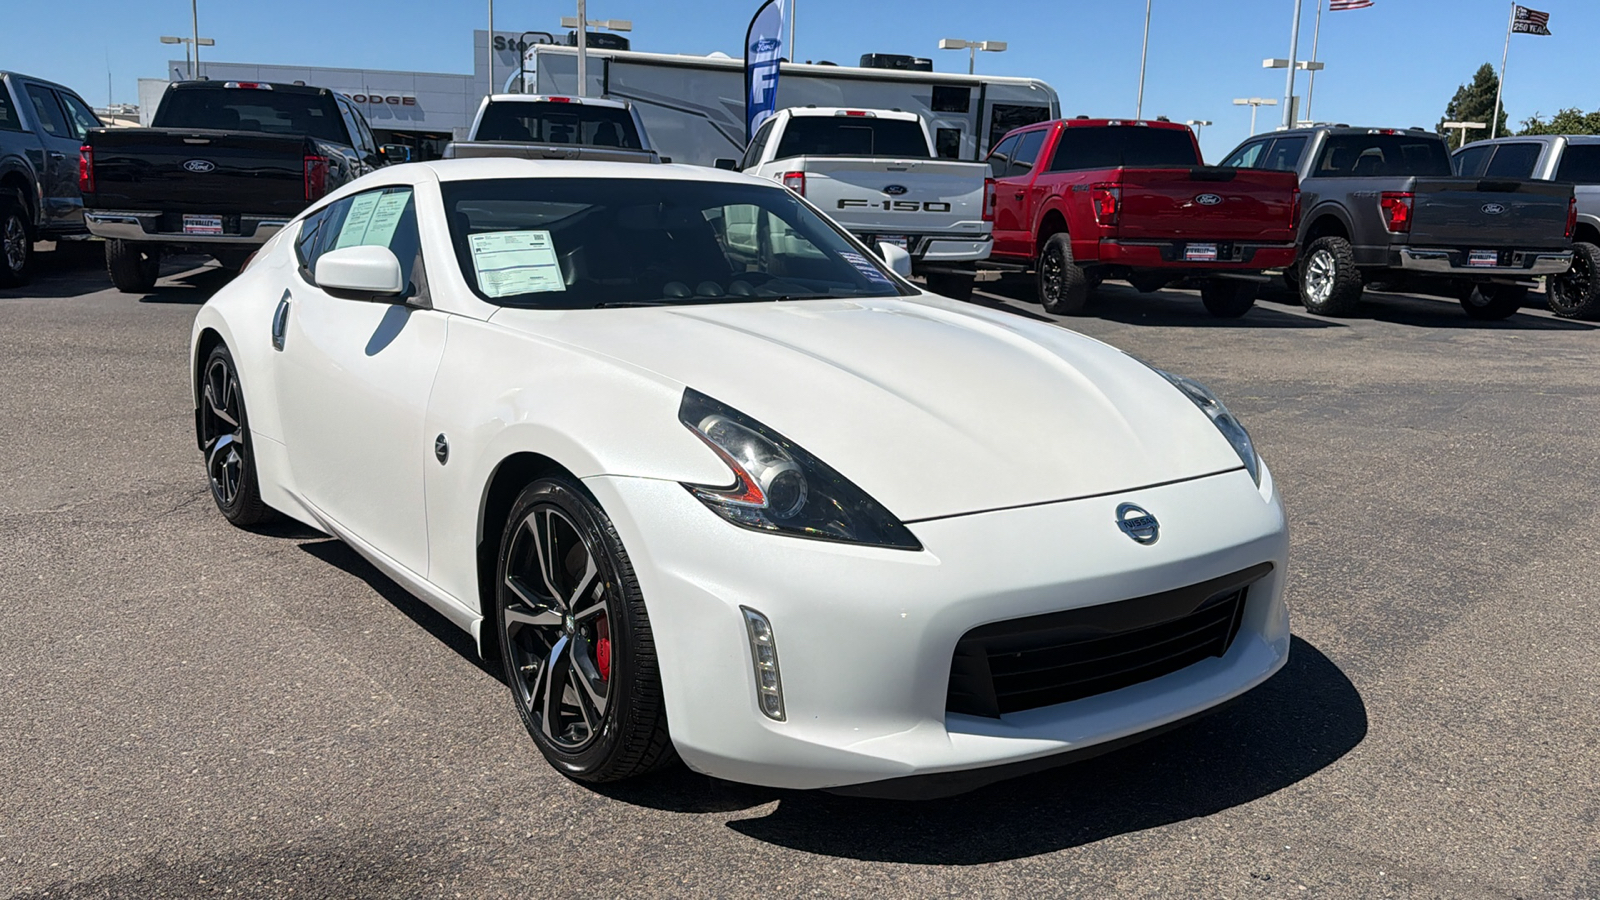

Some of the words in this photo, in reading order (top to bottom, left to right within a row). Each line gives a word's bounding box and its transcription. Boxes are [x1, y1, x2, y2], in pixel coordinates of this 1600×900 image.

[1514, 23, 1528, 31] 250
[757, 40, 776, 52] Ford
[189, 161, 209, 170] Ford
[1200, 196, 1217, 204] Ford
[837, 199, 951, 212] F-150
[1485, 204, 1501, 213] Ford
